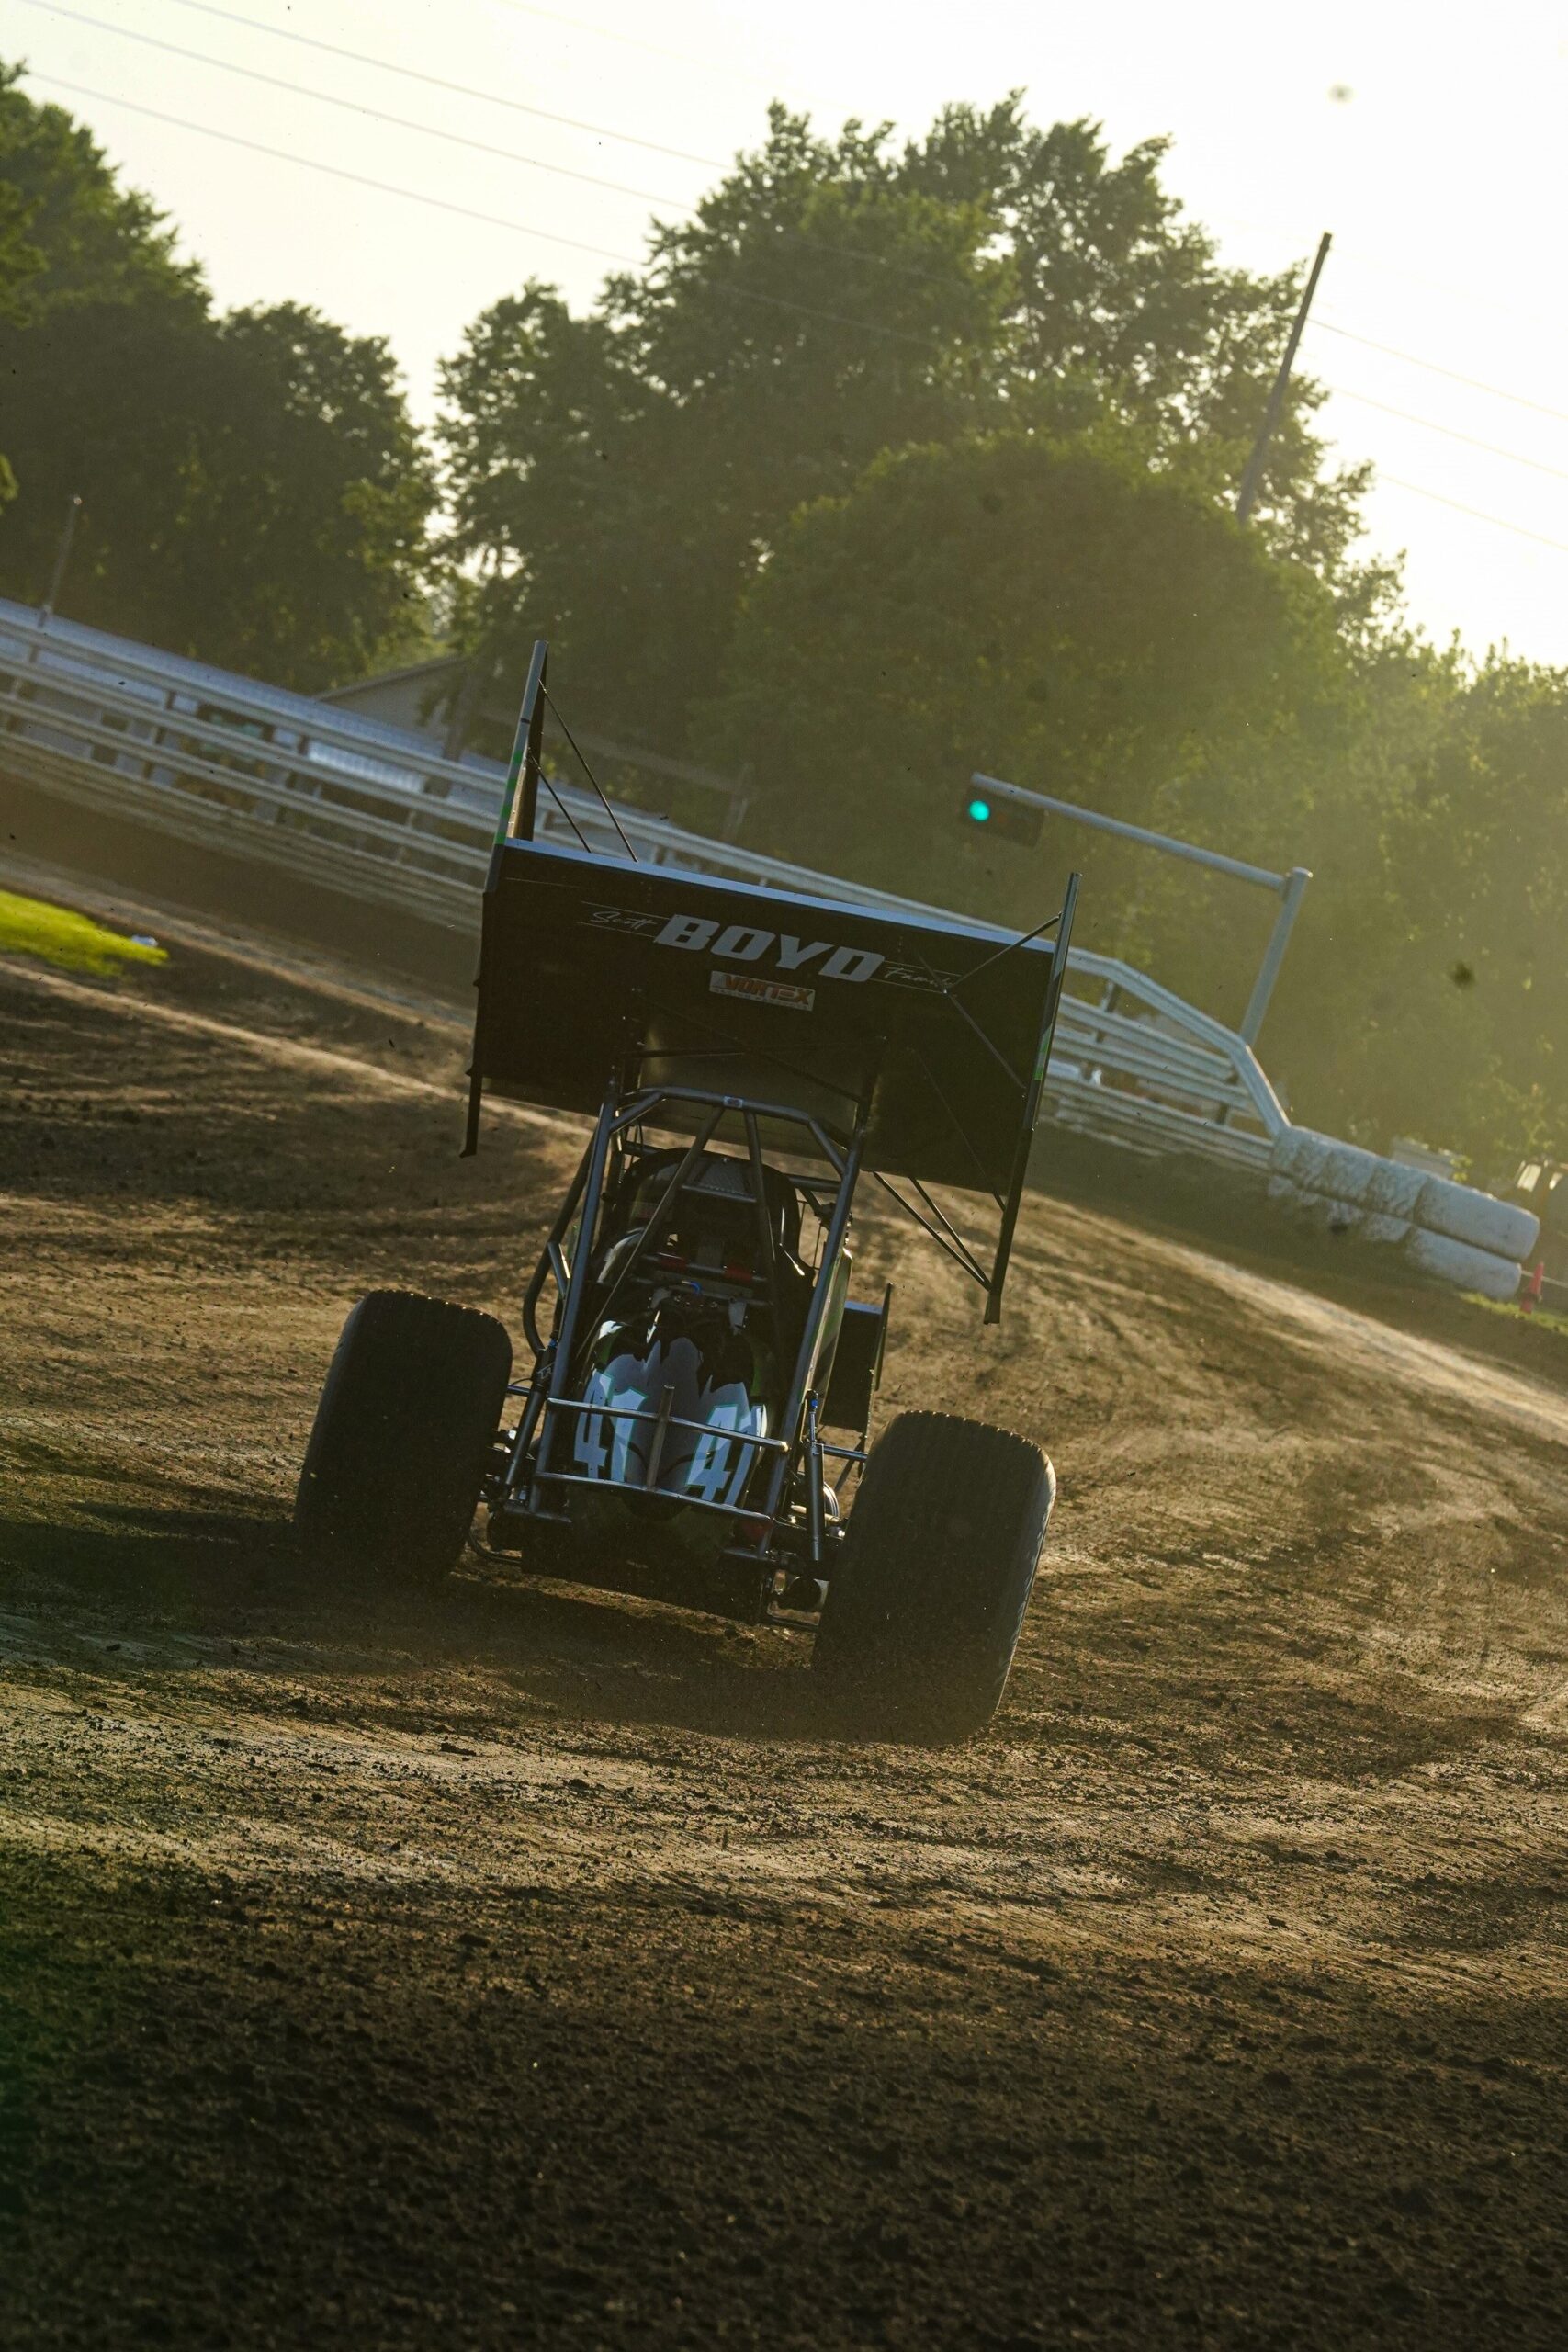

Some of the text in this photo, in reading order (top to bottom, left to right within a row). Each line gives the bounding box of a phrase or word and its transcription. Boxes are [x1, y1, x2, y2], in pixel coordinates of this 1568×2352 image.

[654, 914, 885, 982] BOYD
[573, 1369, 648, 1483] 41
[684, 1403, 763, 1506] 41
